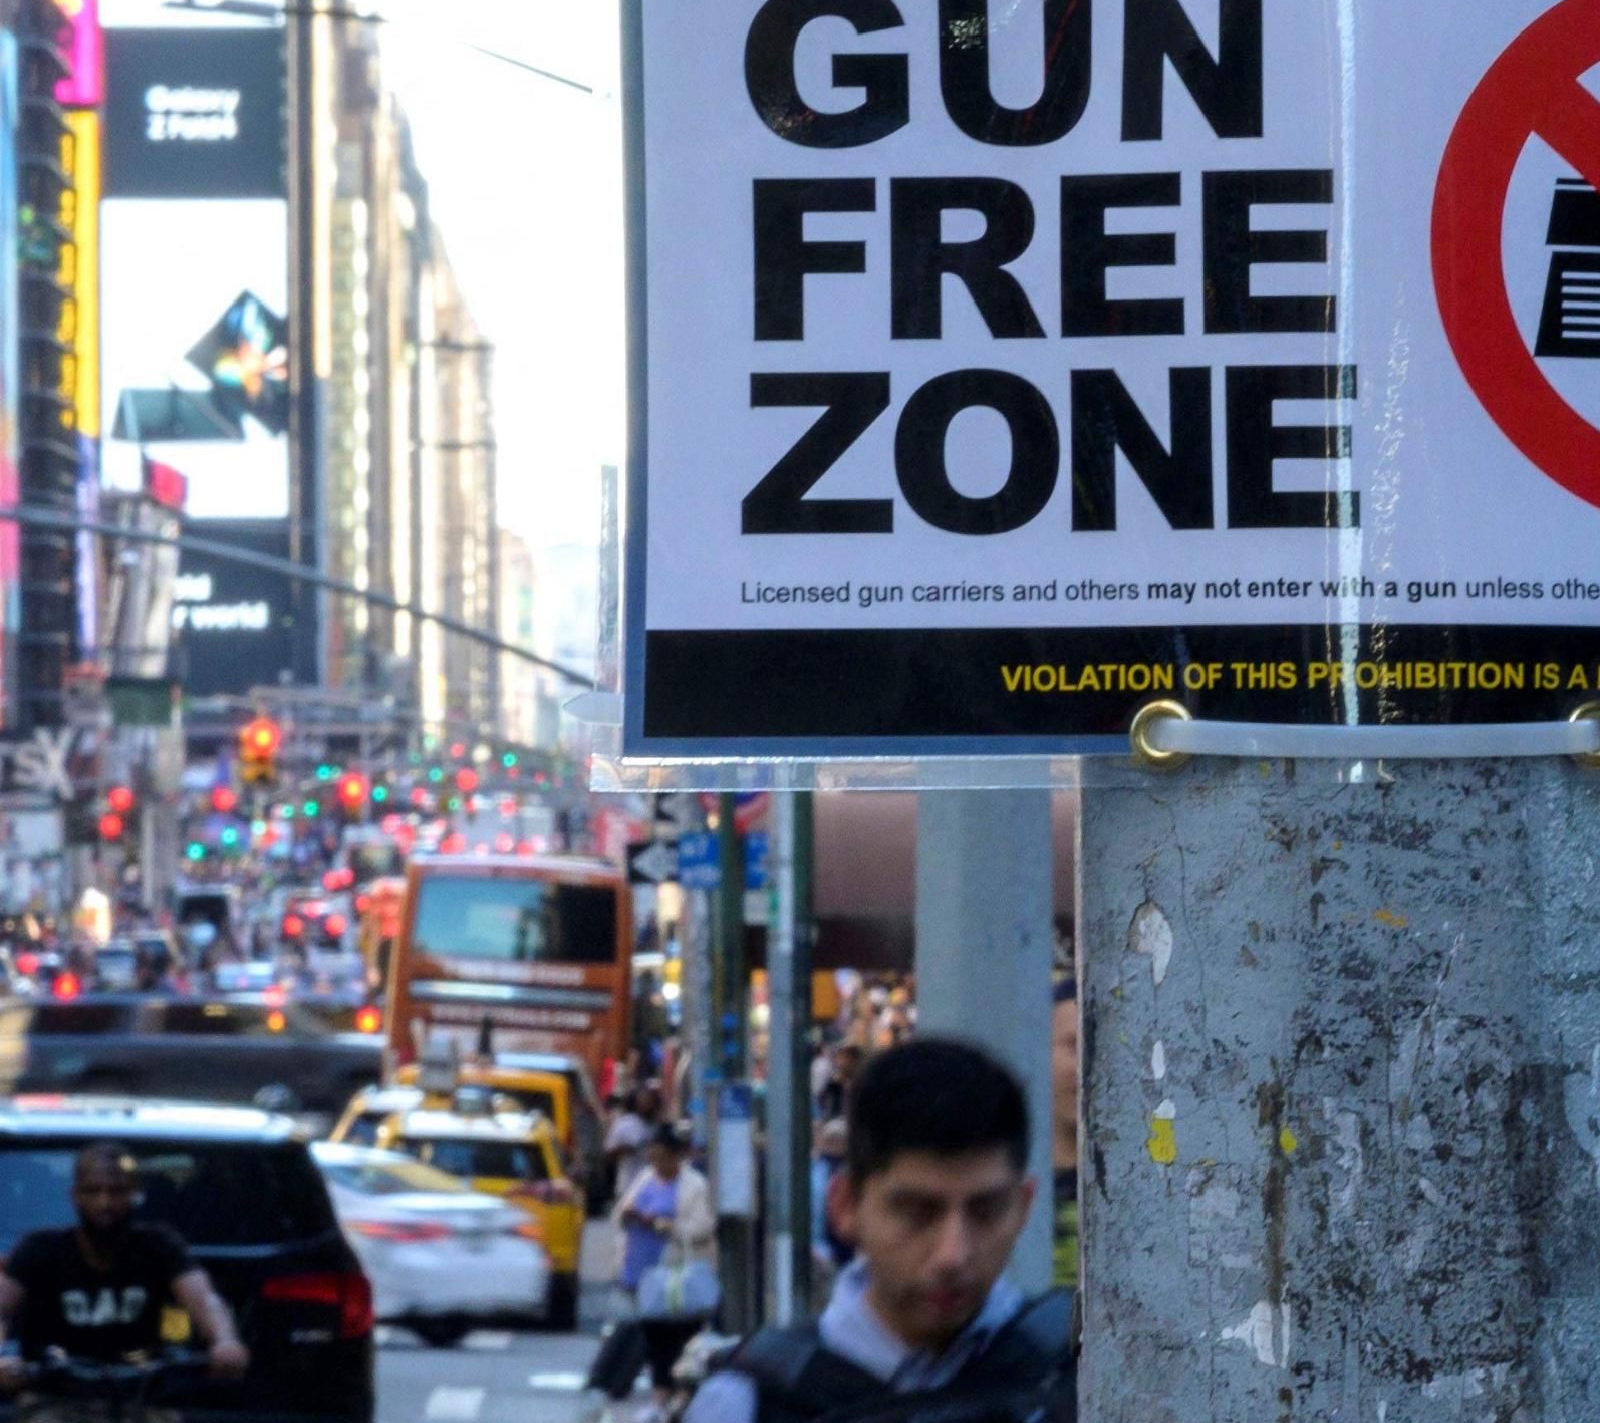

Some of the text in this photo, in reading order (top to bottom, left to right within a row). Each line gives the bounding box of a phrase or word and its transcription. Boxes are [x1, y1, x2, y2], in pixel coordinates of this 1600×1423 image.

[752, 168, 1336, 341] FREE
[741, 364, 1360, 536] ZONE
[741, 580, 851, 604] Licensed
[857, 585, 904, 609] gun
[911, 580, 1005, 603] carriers
[1012, 579, 1057, 602] and
[1064, 578, 1140, 602] others
[1146, 582, 1197, 605] may
[1204, 579, 1241, 600] not
[1247, 578, 1313, 600] enter
[1384, 580, 1399, 598] a
[1406, 580, 1457, 604] gun
[1465, 575, 1545, 600] unless
[1001, 663, 1174, 693] VIOLATION
[1184, 662, 1223, 691] OF
[1231, 661, 1298, 690] THIS
[1307, 661, 1525, 690] PROHIBITION
[1533, 662, 1561, 690] IS
[1567, 663, 1588, 689] A
